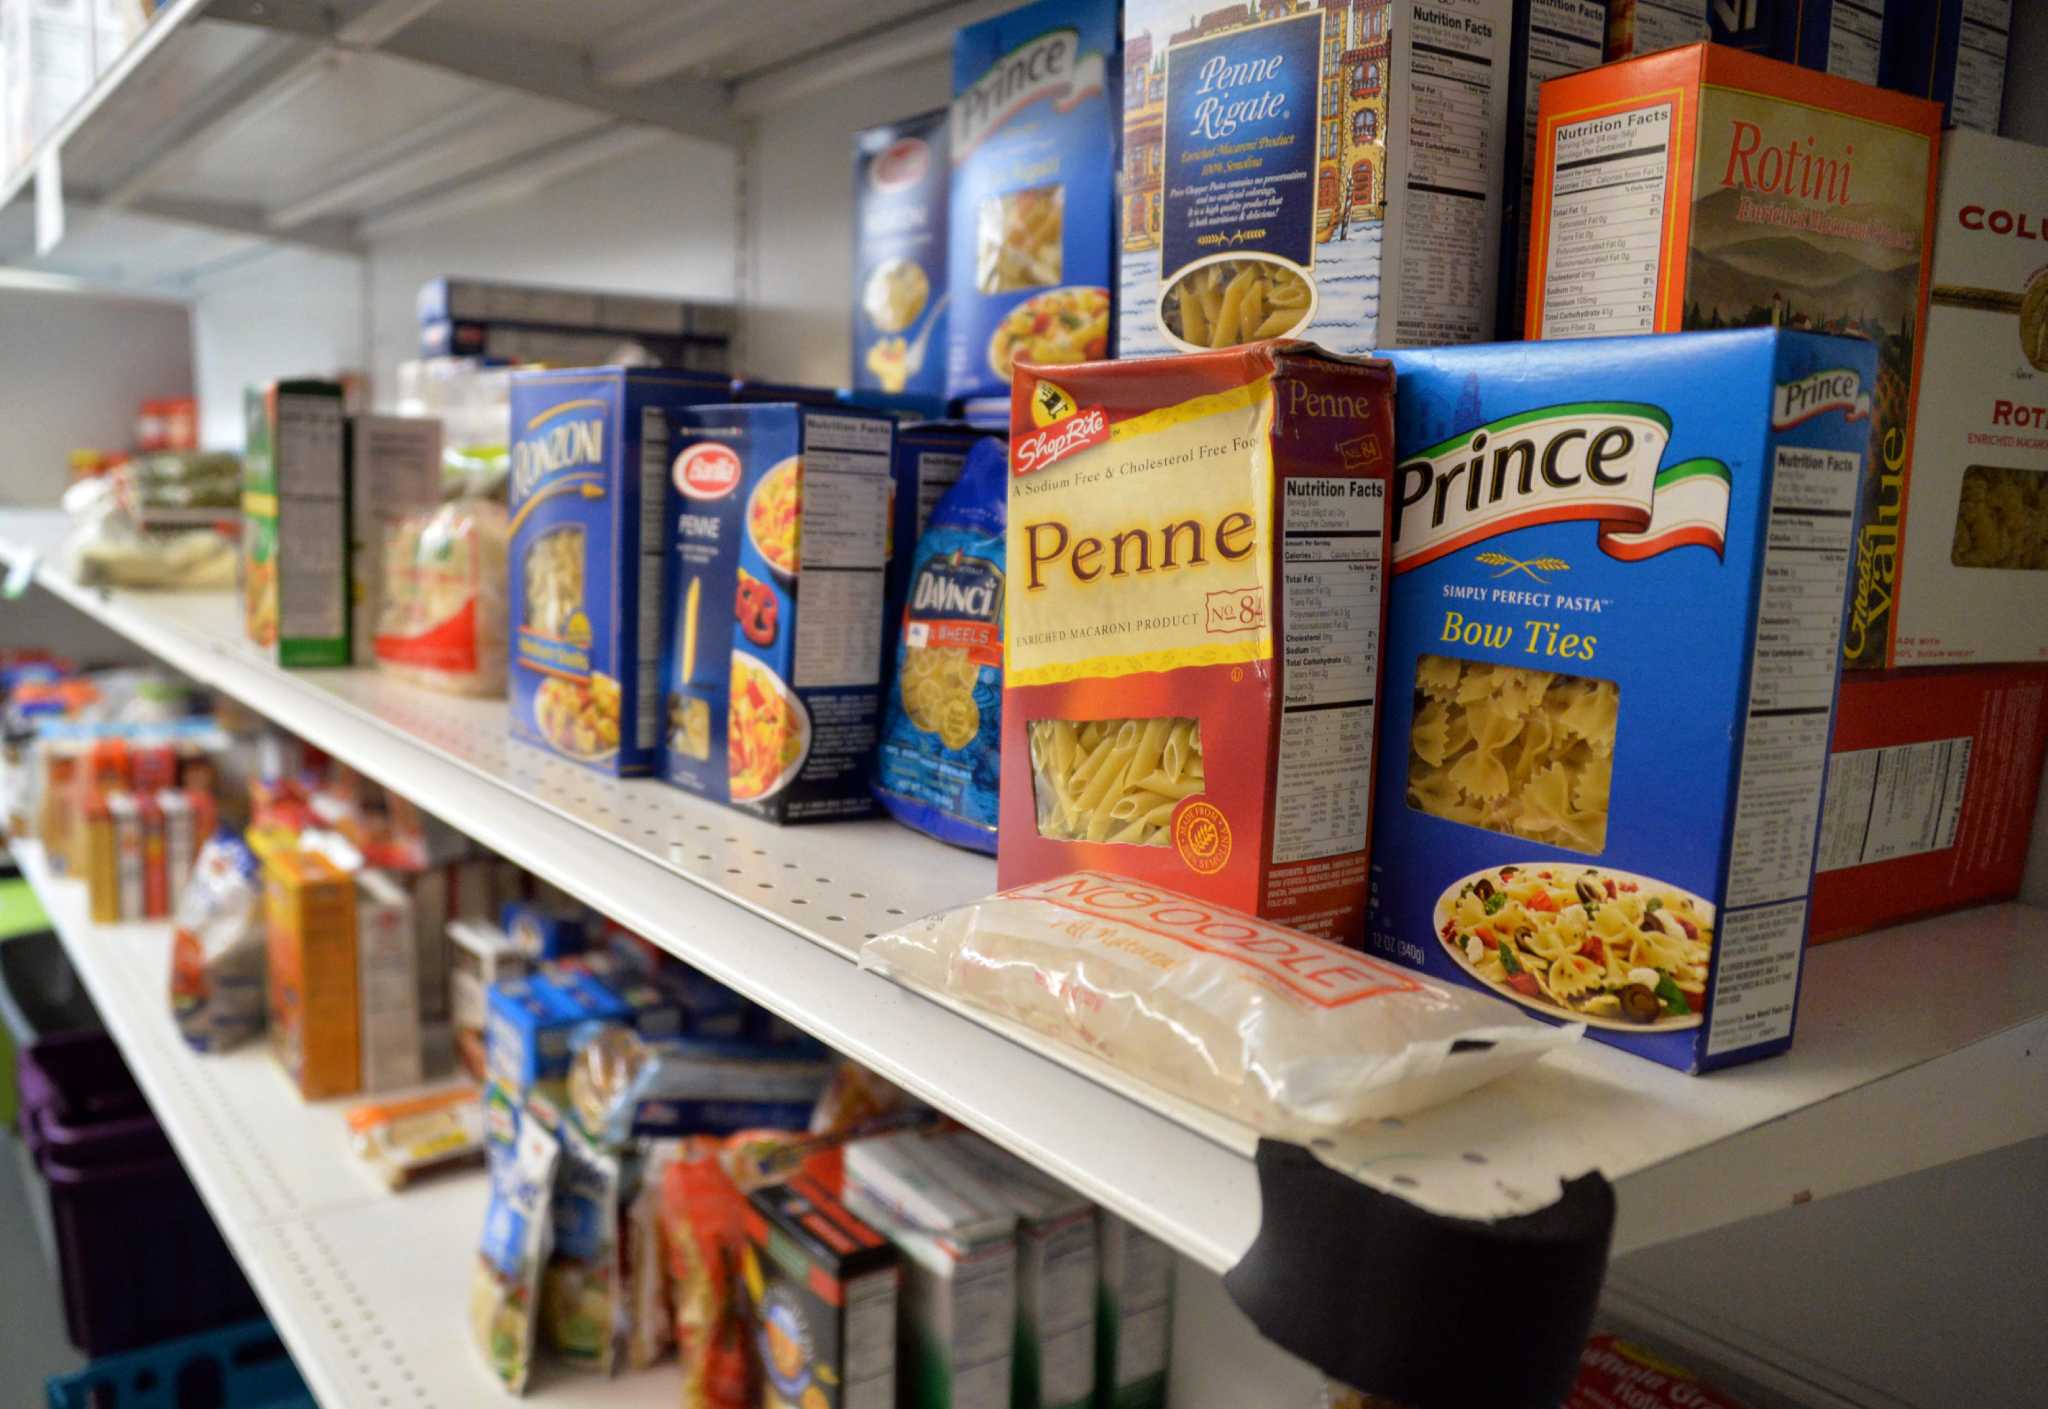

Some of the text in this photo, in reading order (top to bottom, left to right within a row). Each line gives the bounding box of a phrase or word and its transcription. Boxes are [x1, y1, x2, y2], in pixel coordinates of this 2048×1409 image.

[1413, 6, 1462, 29] Nutrition
[1465, 18, 1493, 38] Facts
[1578, 6, 1603, 21] Facts
[1196, 55, 1284, 95] Penne
[1557, 109, 1669, 141] Nutrition Facts
[1720, 120, 1855, 206] Rotini
[1289, 379, 1371, 419] Penne
[1785, 374, 1855, 417] Prince
[1017, 409, 1105, 474] ShopRite
[1012, 436, 1258, 497] A Sodium Free & Cholesterol Free Foo
[1777, 452, 1854, 474] Nutrition Facts
[1286, 480, 1384, 498] Nutrition Facts
[1392, 424, 1636, 544] Prince
[1024, 511, 1258, 592] Penne
[1284, 551, 1312, 561] Calories
[1843, 427, 1907, 660] Great Value
[1285, 575, 1314, 584] Total Fat
[1442, 584, 1603, 614] SIMPLY PERFECT PASTA
[1016, 611, 1201, 647] ENRICHED MACARONI PRODUCT
[1440, 611, 1598, 661] Bow Ties
[1285, 646, 1310, 655] Sodium
[1383, 936, 1396, 953] OZ
[1397, 938, 1425, 967] (340g)
